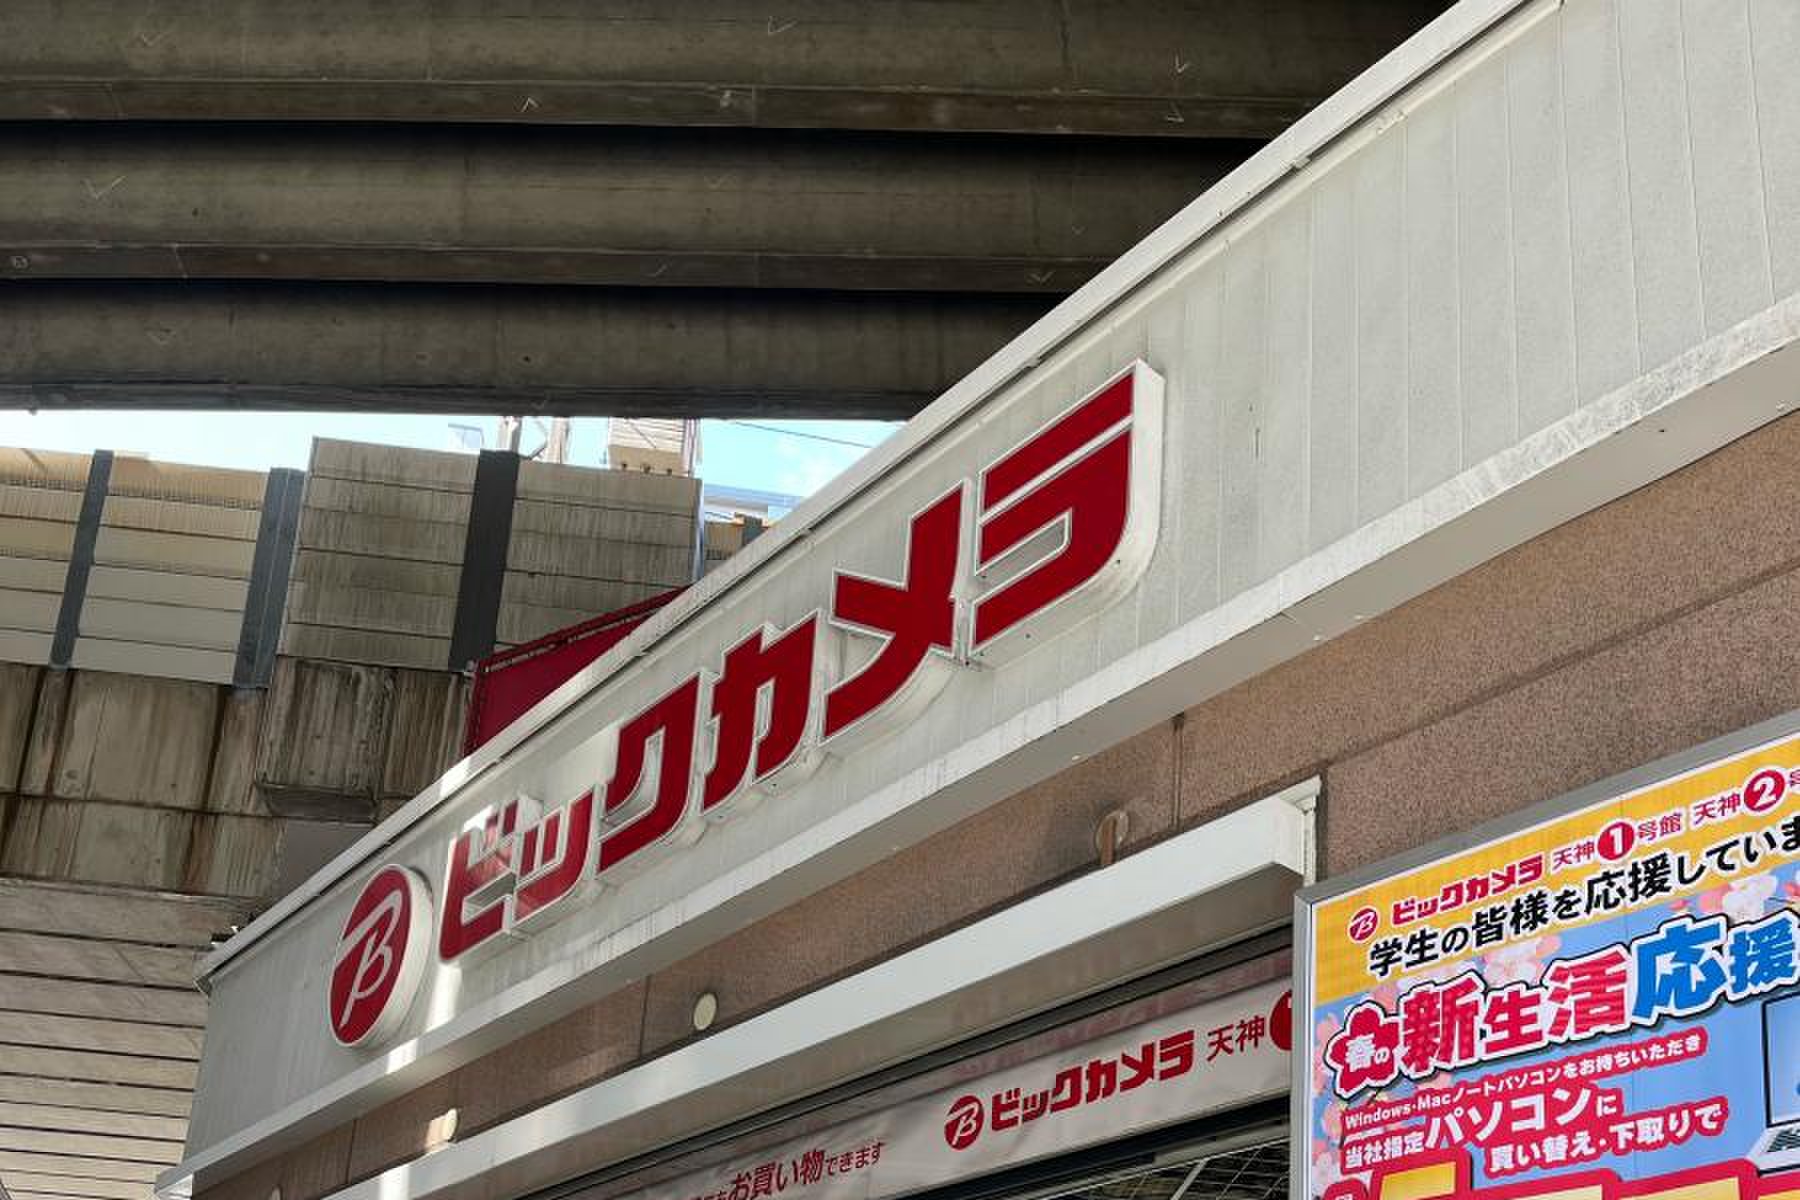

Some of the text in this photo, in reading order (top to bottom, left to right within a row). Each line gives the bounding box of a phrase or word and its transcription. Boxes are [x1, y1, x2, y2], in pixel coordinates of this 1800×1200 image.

[439, 364, 1140, 964] ビックカメラ
[1391, 856, 1544, 925] ビックカメラ
[992, 1030, 1194, 1131] ビックカメラ
[1207, 989, 1292, 1062] 天神
[1401, 915, 1796, 1072] 新生活応援
[1345, 1087, 1618, 1169] 当社指定 パソコンに
